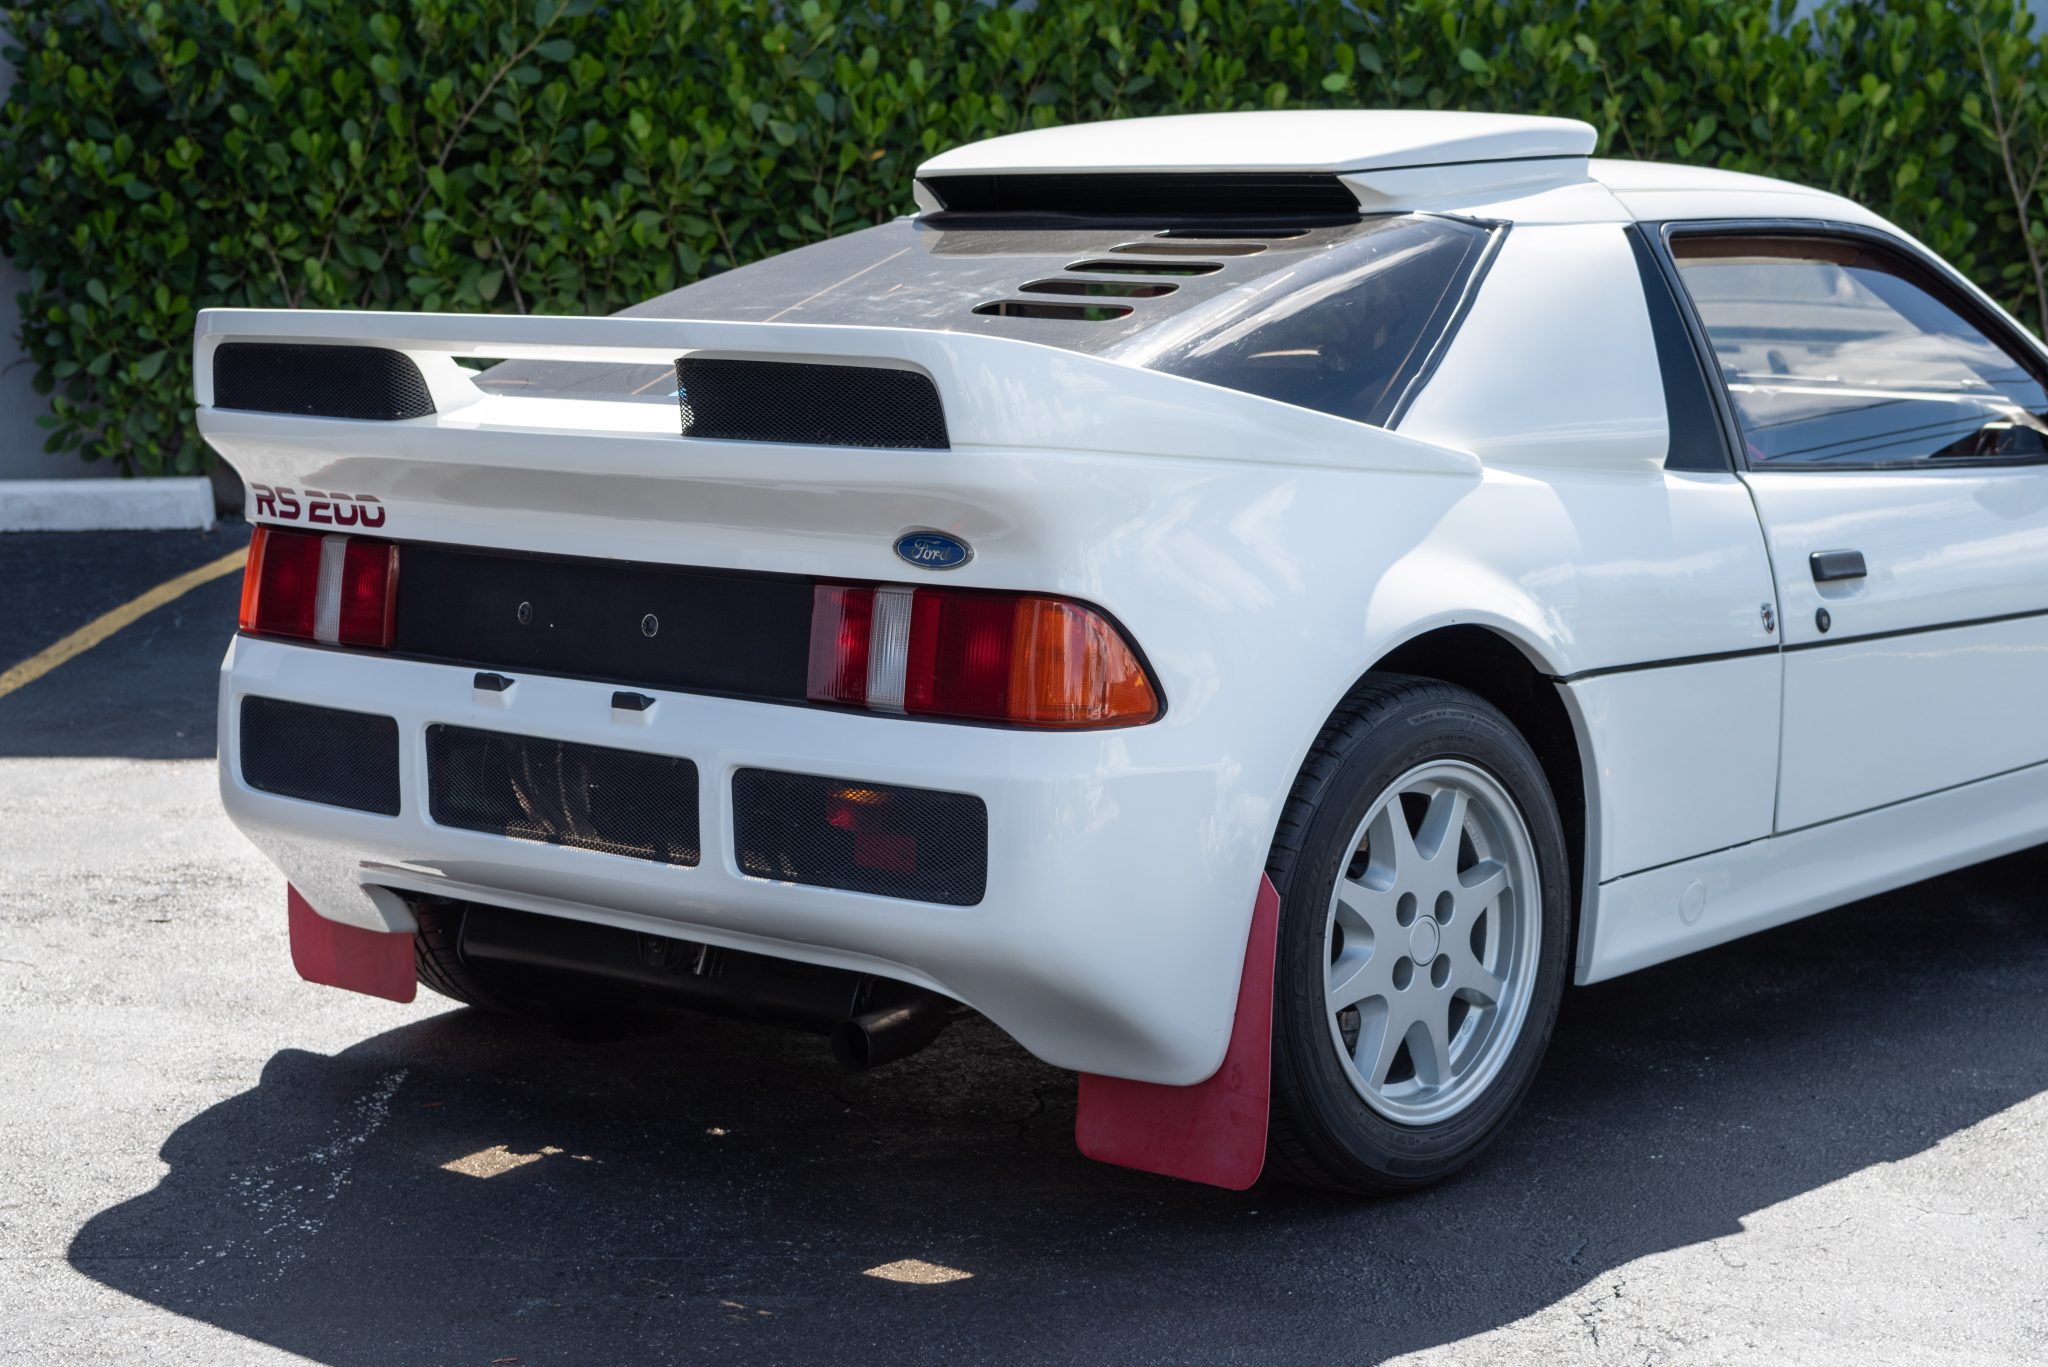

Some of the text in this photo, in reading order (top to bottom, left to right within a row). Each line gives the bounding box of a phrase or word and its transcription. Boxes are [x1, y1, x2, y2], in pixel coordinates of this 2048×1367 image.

[251, 483, 386, 528] RS 200
[912, 539, 952, 561] Ford
